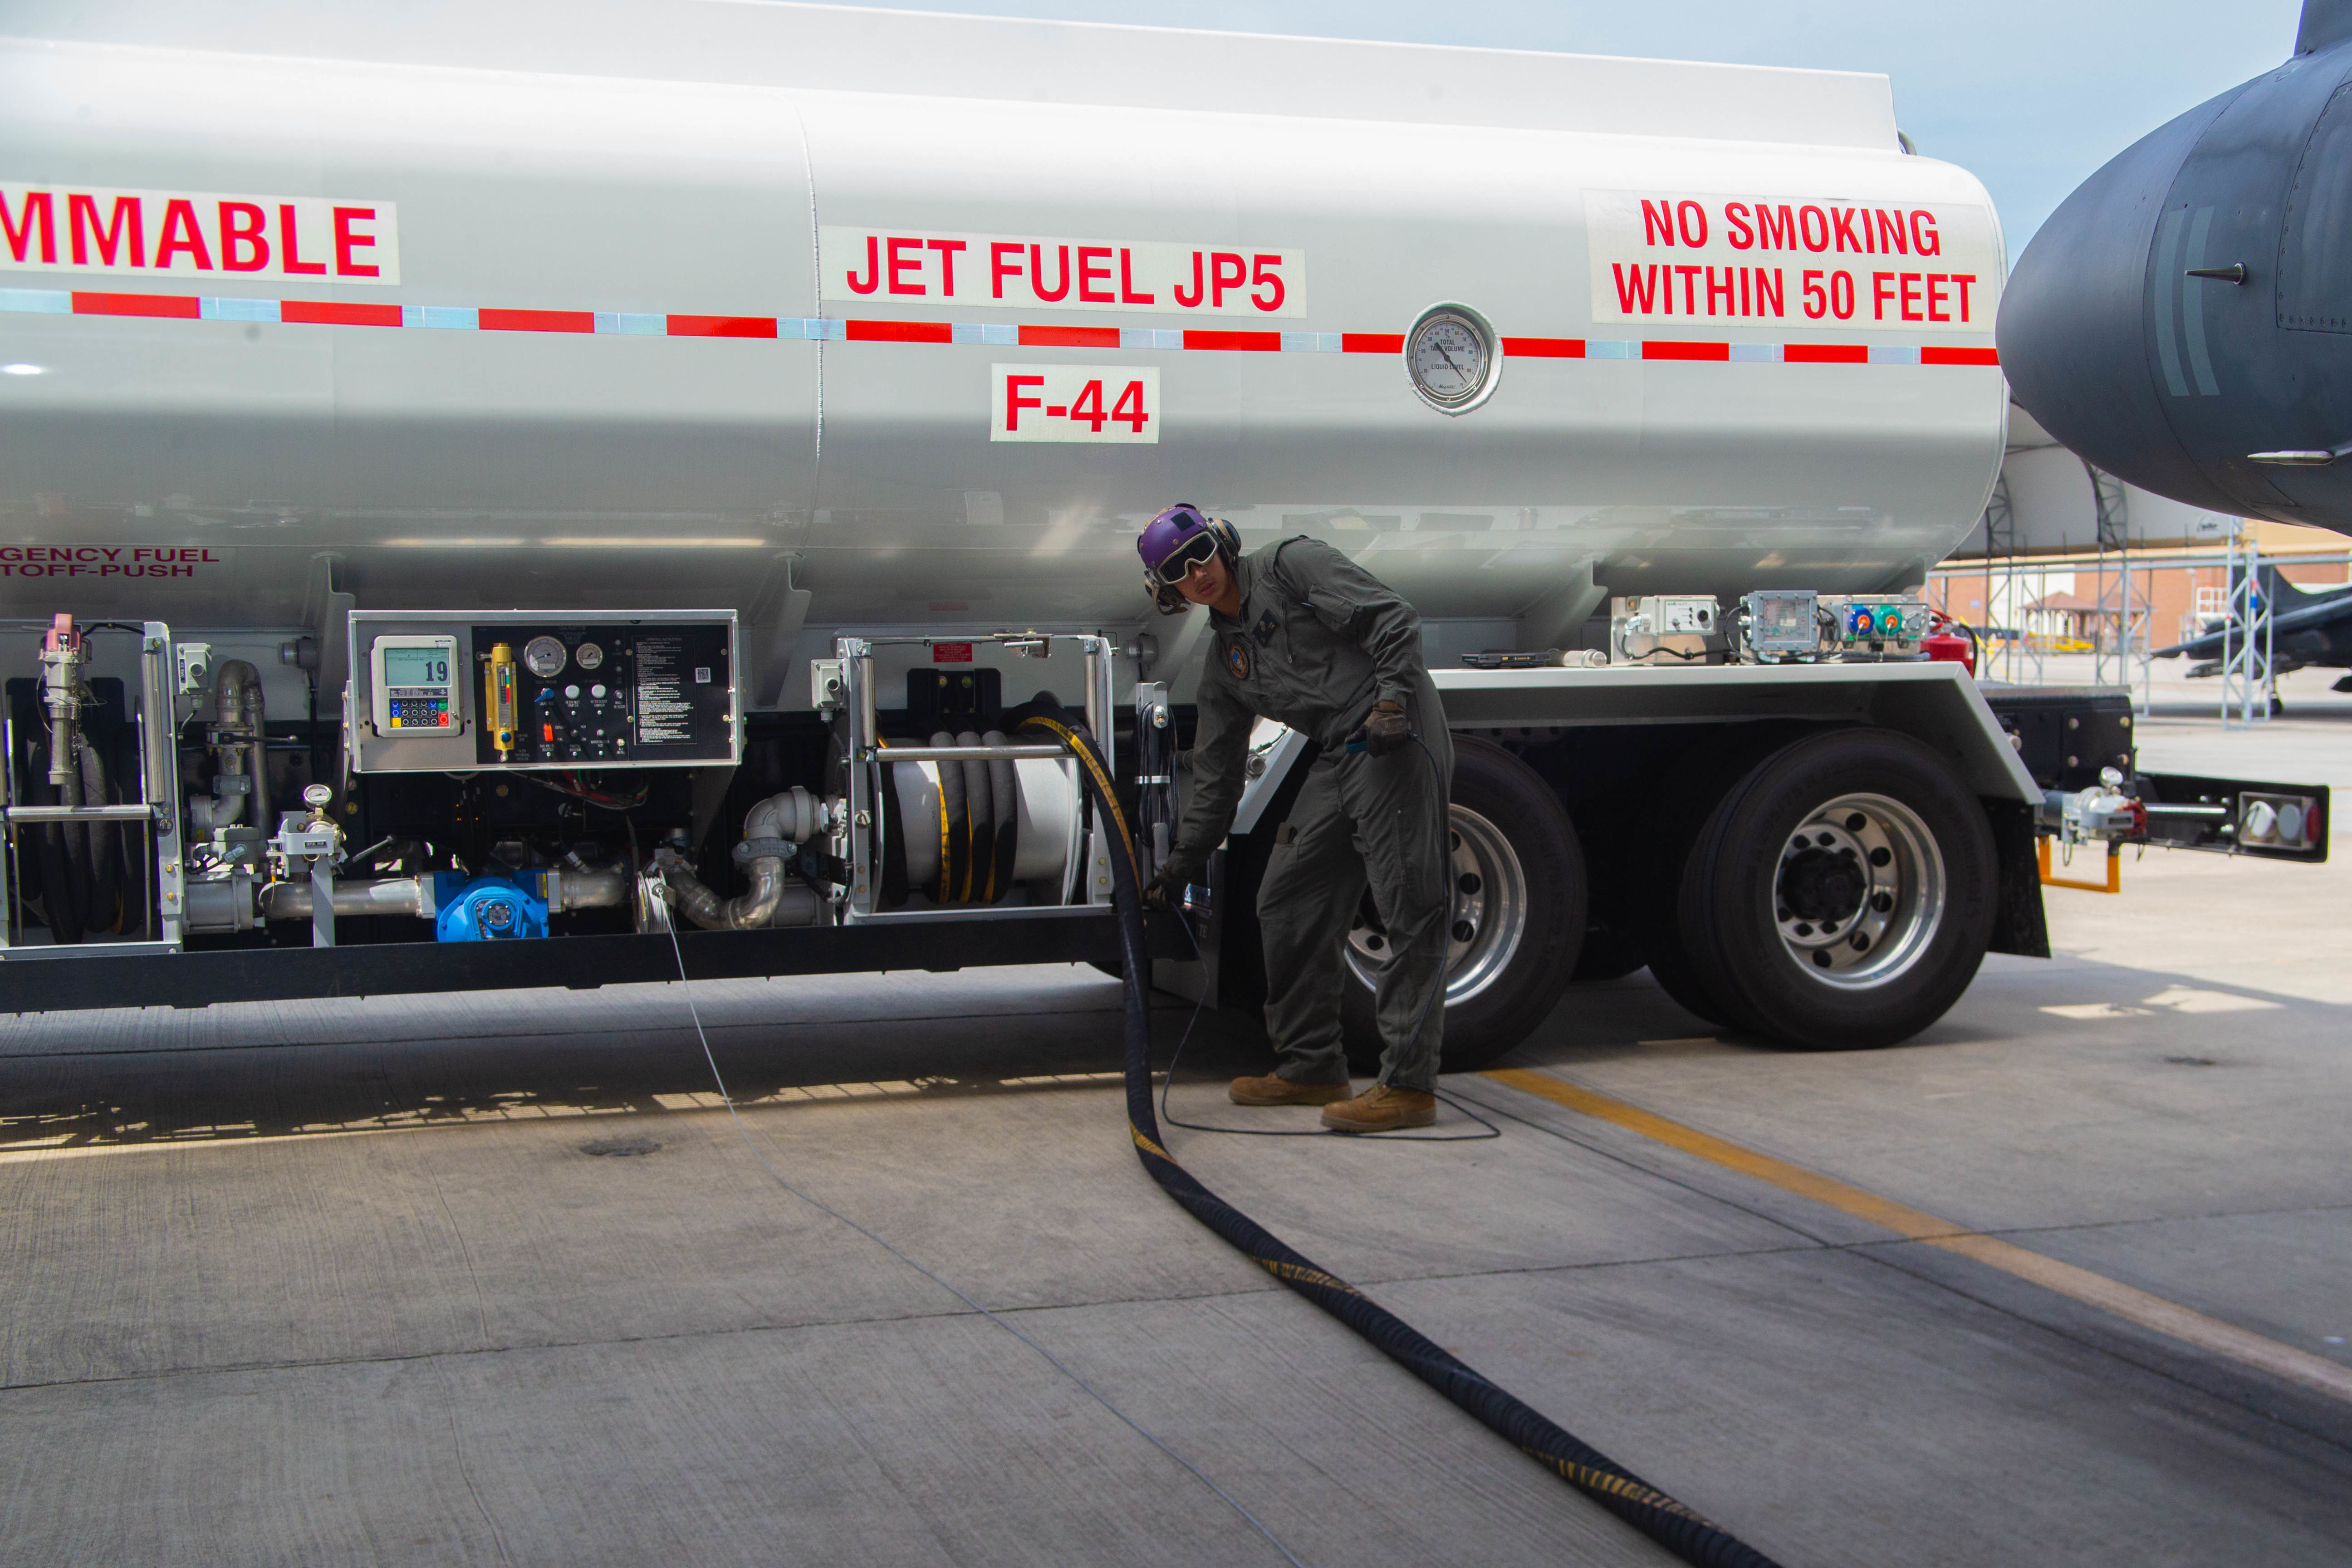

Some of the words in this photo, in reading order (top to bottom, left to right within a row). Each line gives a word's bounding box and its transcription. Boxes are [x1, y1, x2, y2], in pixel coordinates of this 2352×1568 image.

[0, 191, 380, 277] MMABLE
[1641, 200, 1708, 248] NO
[1725, 202, 1940, 256] SMOKING
[846, 235, 966, 297] JET
[990, 242, 1155, 305] FUEL
[1174, 251, 1285, 312] JP5
[1612, 263, 1784, 317] WITHIN
[1802, 270, 1854, 320] 50
[1872, 272, 1976, 322] FEET
[1006, 374, 1148, 433] F-44
[0, 548, 122, 562] GENCY
[134, 549, 220, 562] FUEL
[0, 564, 193, 577] TOFF-PUSH
[426, 661, 448, 681] 19
